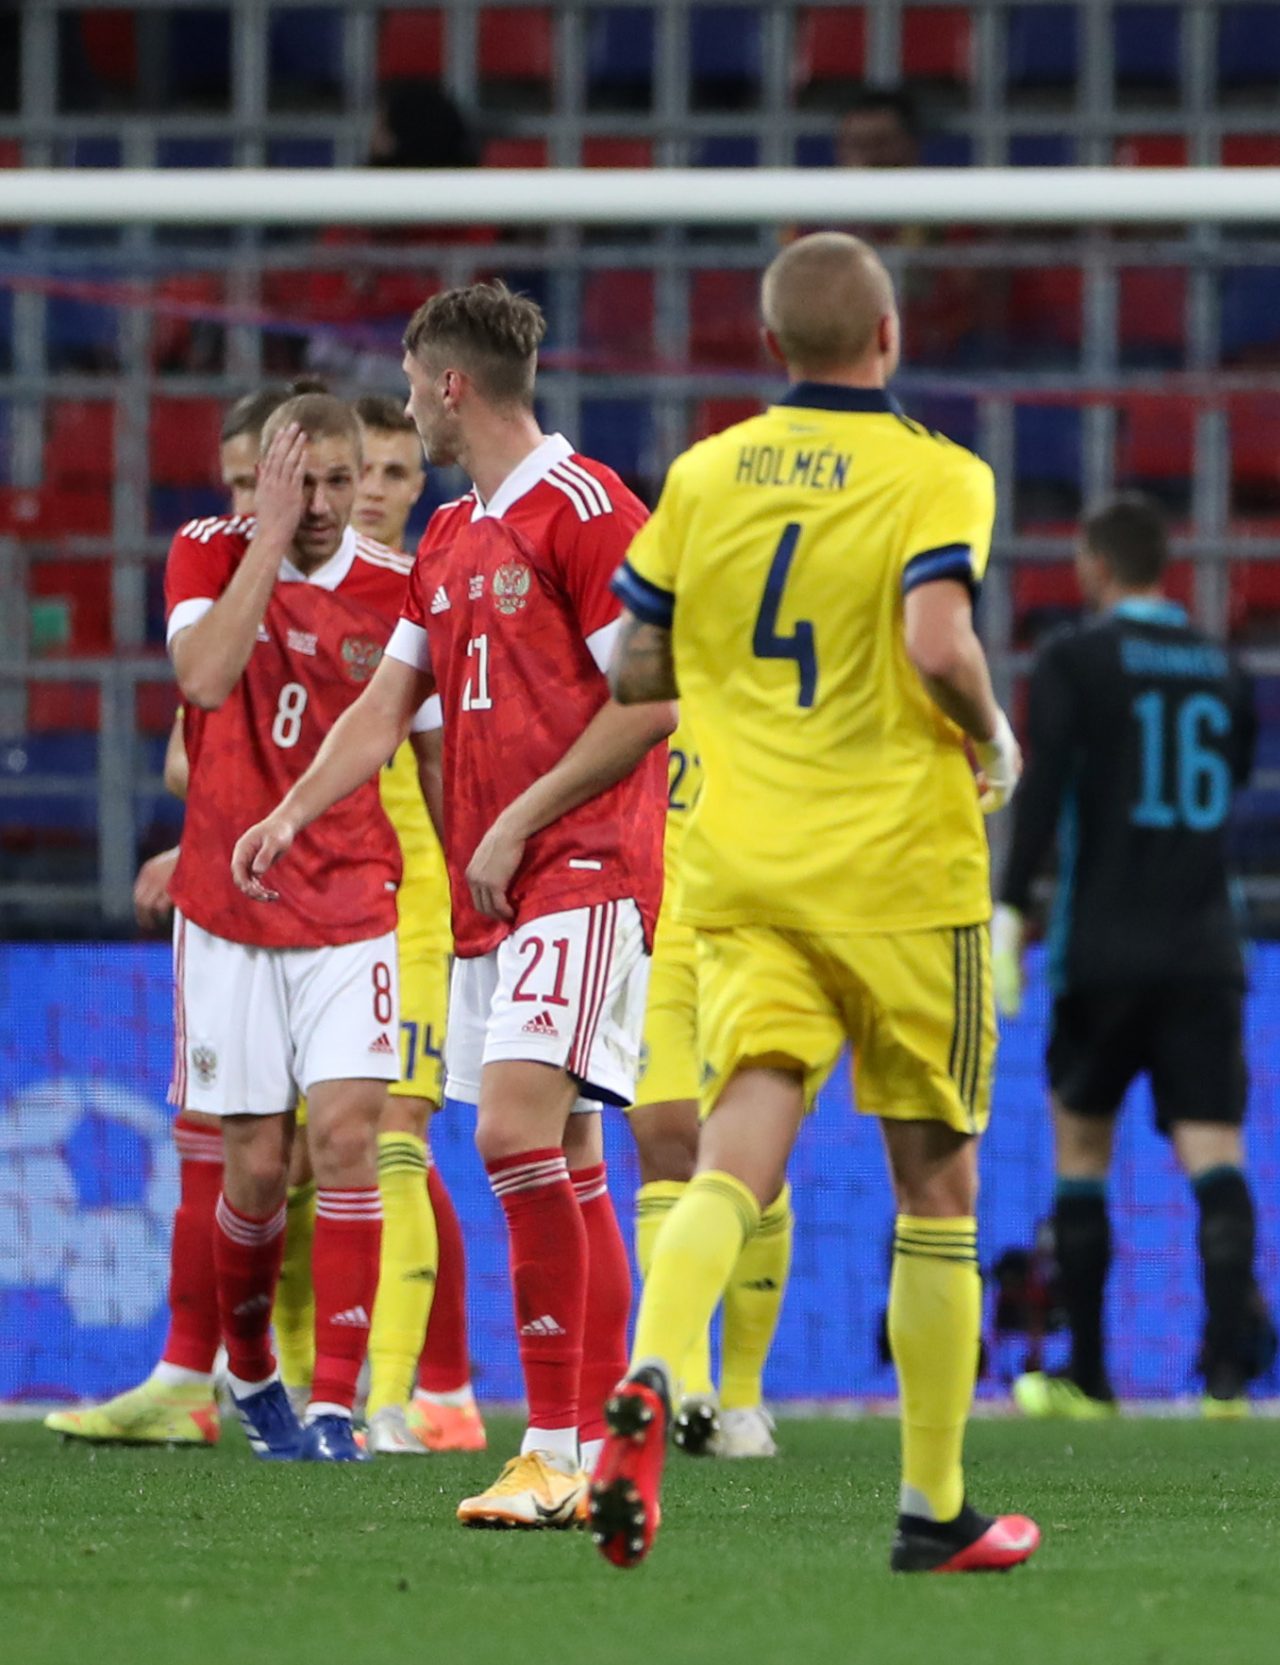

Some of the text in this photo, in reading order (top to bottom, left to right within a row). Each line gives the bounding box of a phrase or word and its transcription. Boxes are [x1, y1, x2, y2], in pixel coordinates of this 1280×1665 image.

[736, 443, 853, 491] HOLMÉN
[752, 522, 818, 709] 4
[271, 682, 308, 749] 8
[669, 750, 700, 811] 2
[1131, 690, 1231, 830] 16
[372, 961, 392, 1025] 8
[512, 936, 569, 1007] 21
